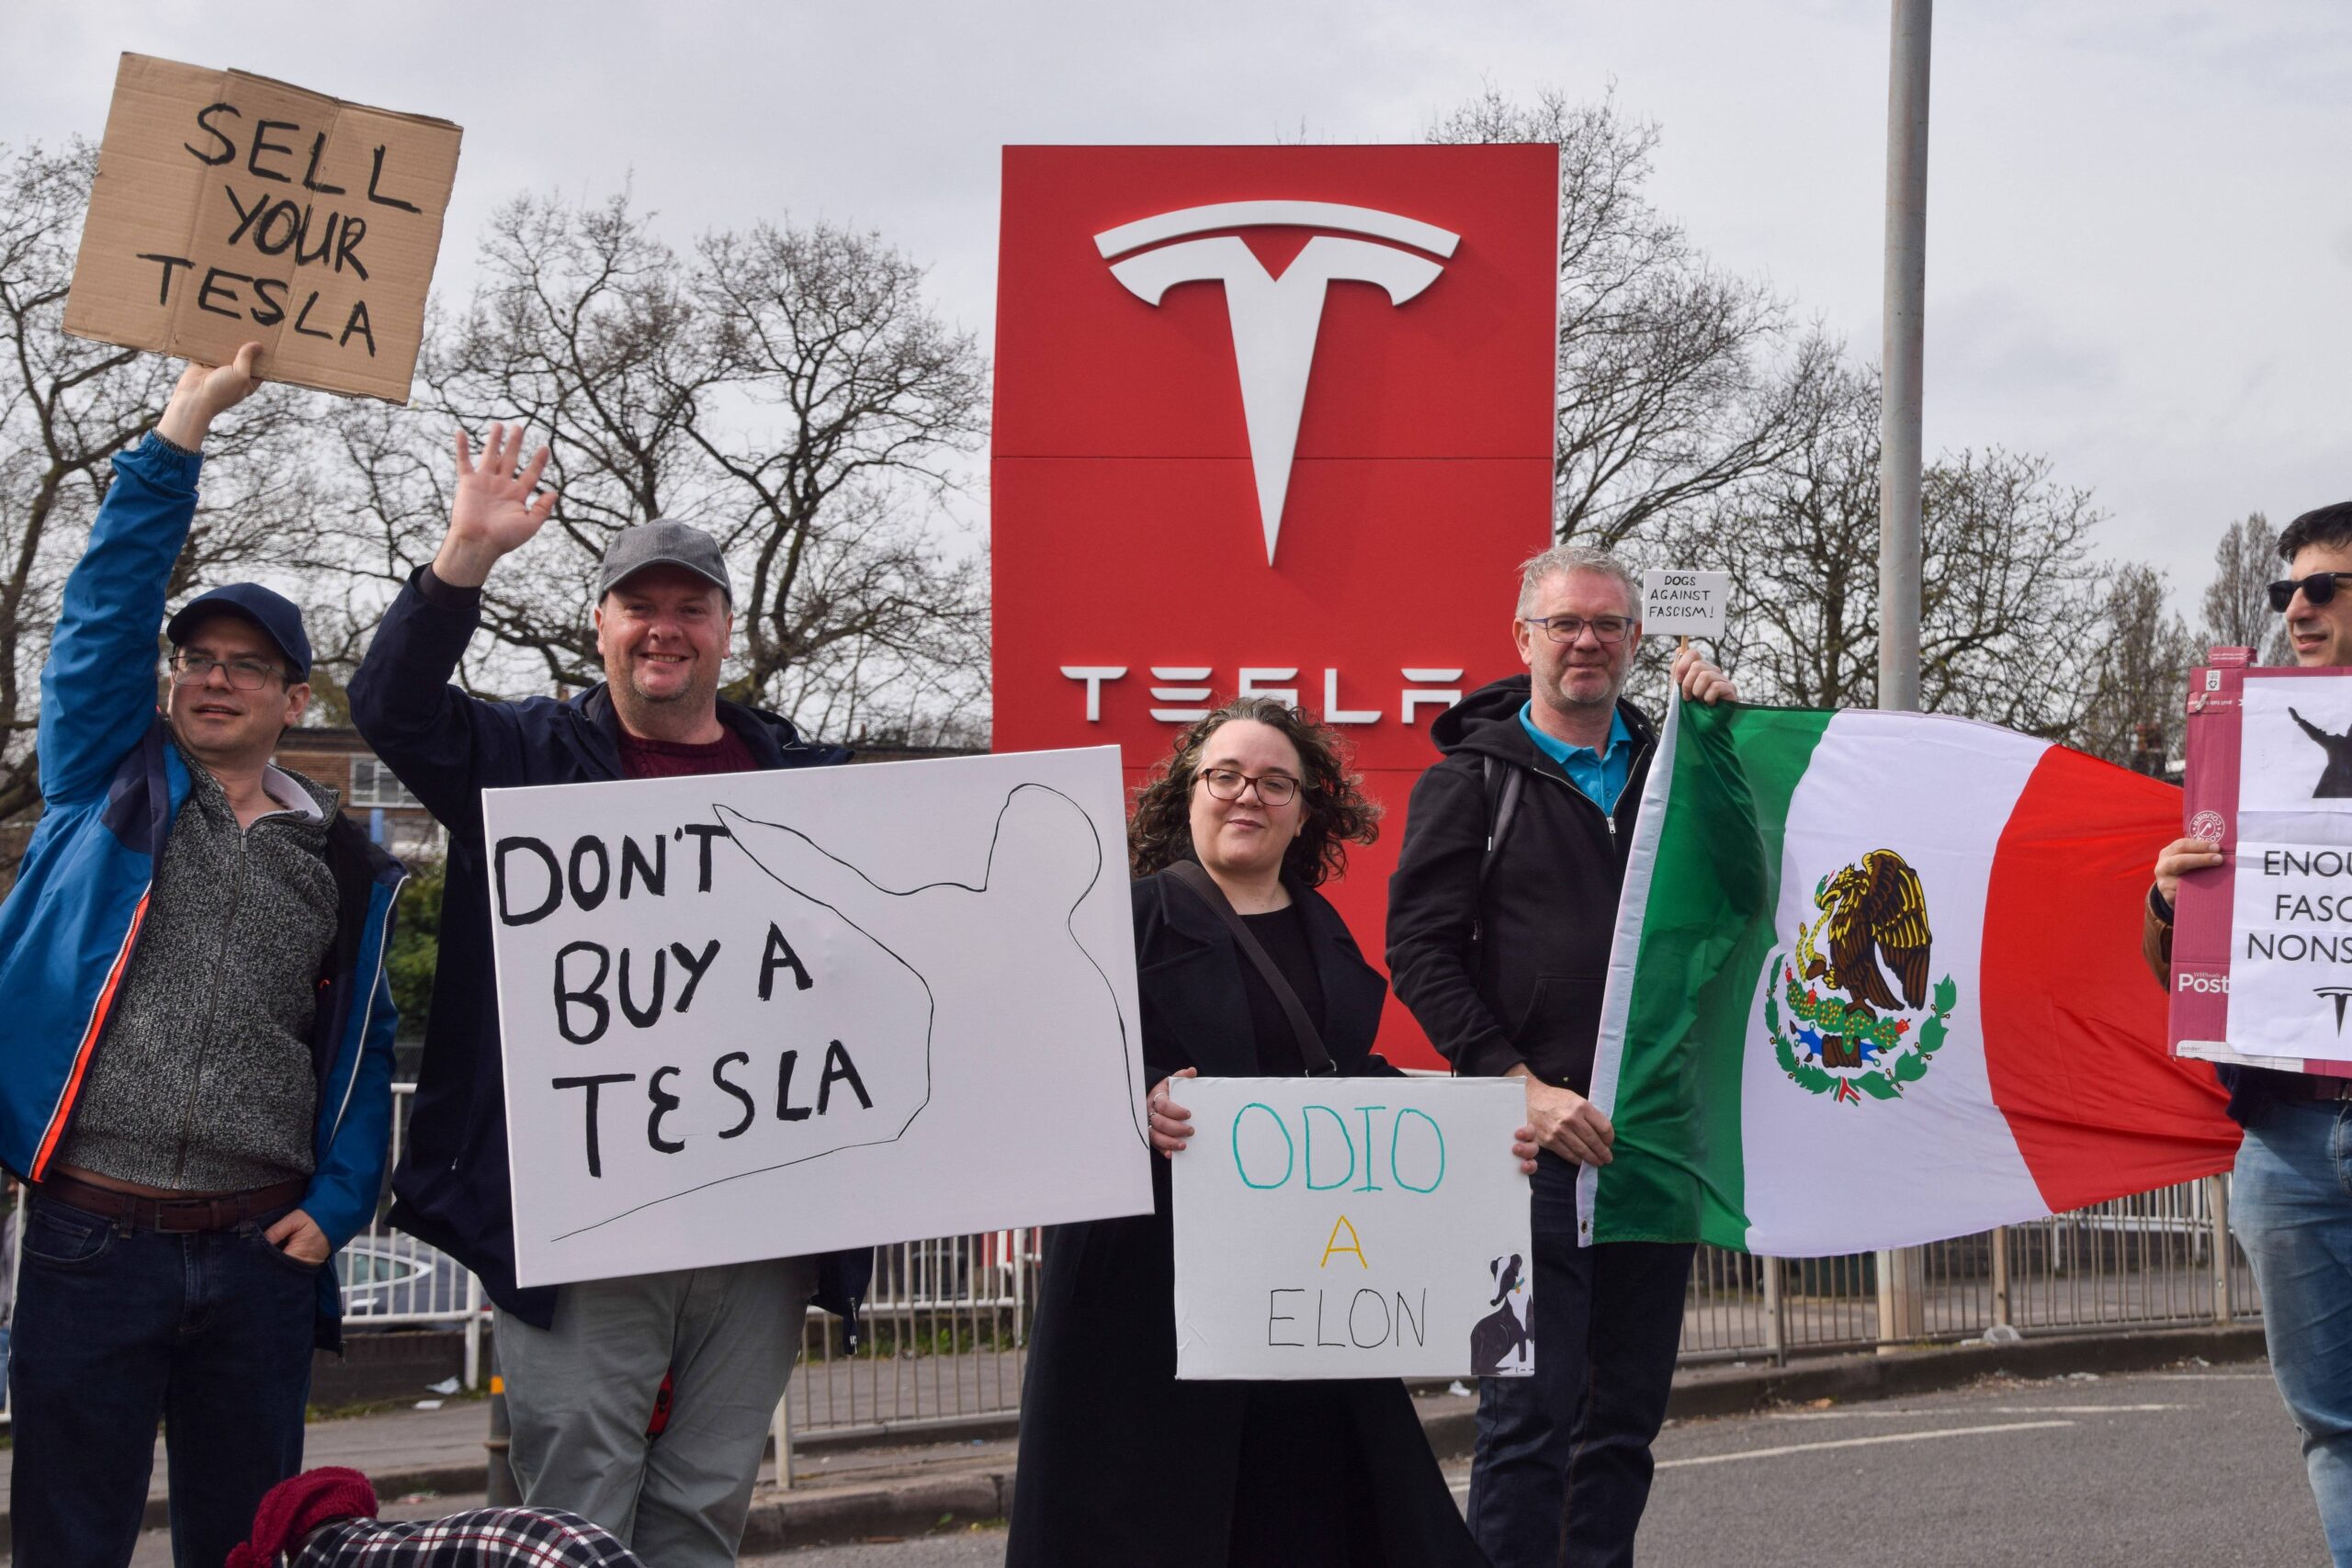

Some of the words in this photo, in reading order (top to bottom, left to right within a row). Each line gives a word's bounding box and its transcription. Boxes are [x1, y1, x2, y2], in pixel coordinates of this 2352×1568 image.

[185, 102, 422, 214] SELL
[225, 185, 369, 280] YOUR
[136, 253, 376, 357] TESLA
[1650, 589, 1711, 601] AGAINST
[1664, 575, 1696, 586] DOGS
[1649, 606, 1713, 618] FASCISM!
[1059, 666, 1464, 724] TESLA
[2192, 813, 2222, 826] COURIER
[494, 823, 730, 927] DON'T
[2264, 851, 2352, 877] ENO
[2247, 932, 2352, 964] NONS
[553, 939, 721, 1045] BUY
[758, 920, 813, 1001] A
[2178, 973, 2230, 993] Post
[552, 1039, 873, 1179] TESLA
[1232, 1102, 1445, 1193] ODIO
[1320, 1214, 1368, 1269] A
[1269, 1288, 1426, 1349] ELON
